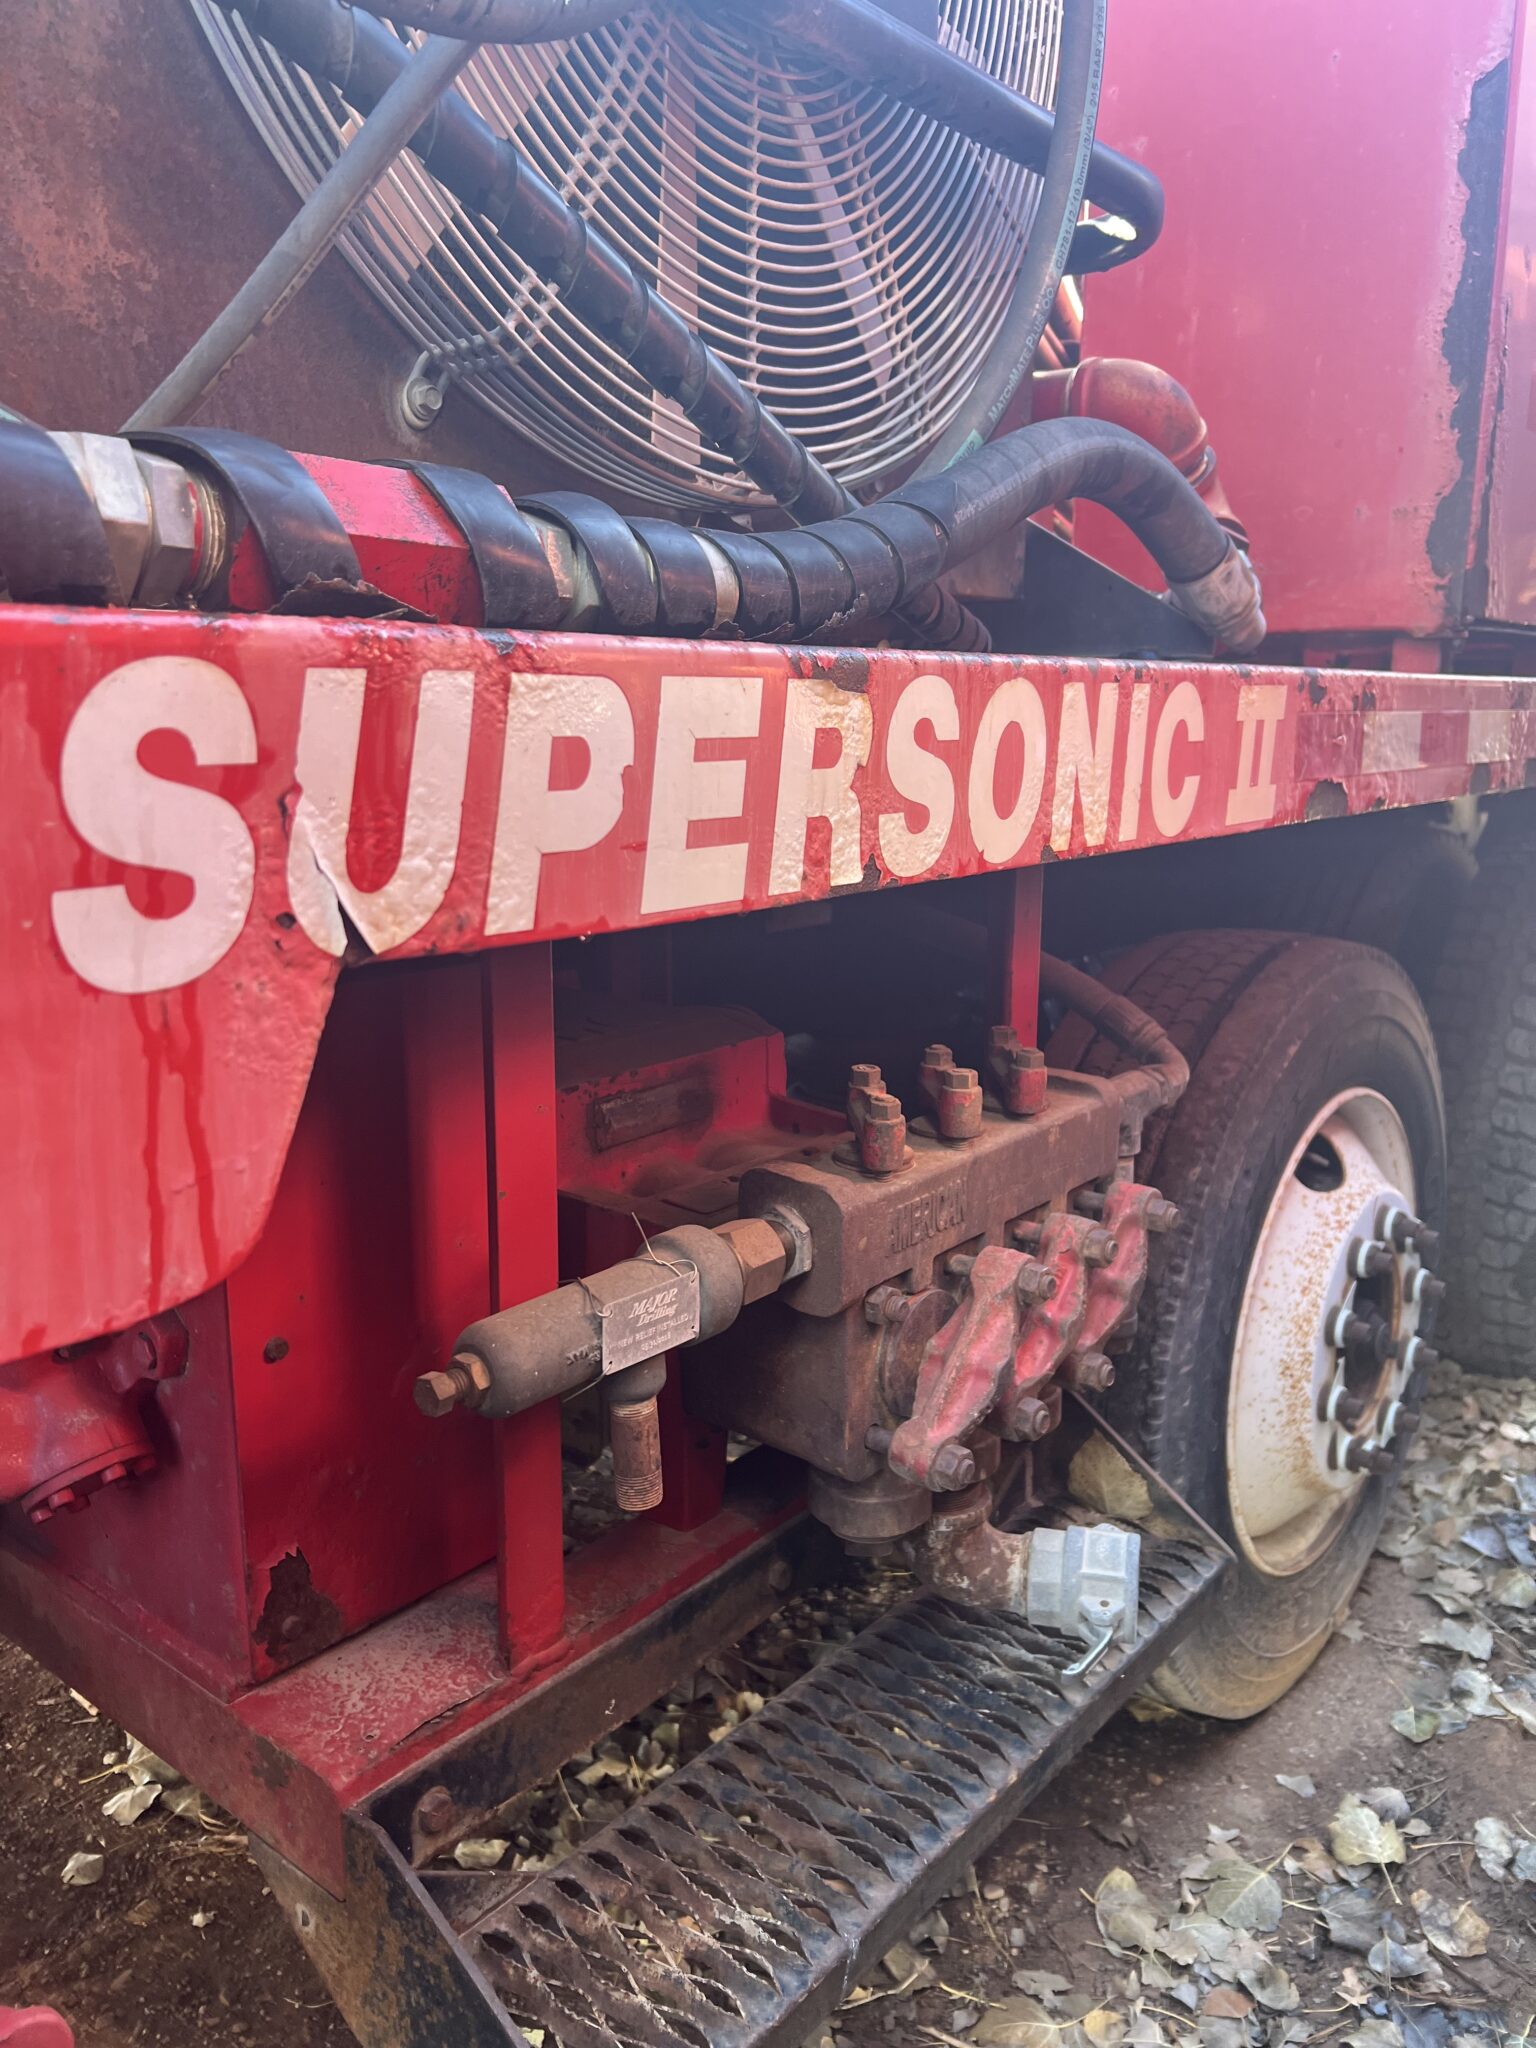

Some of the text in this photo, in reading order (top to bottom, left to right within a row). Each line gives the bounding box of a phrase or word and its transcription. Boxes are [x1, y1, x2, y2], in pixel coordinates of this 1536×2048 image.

[52, 655, 1288, 994] SUPERSONIC II
[888, 1178, 967, 1255] AMERICAN
